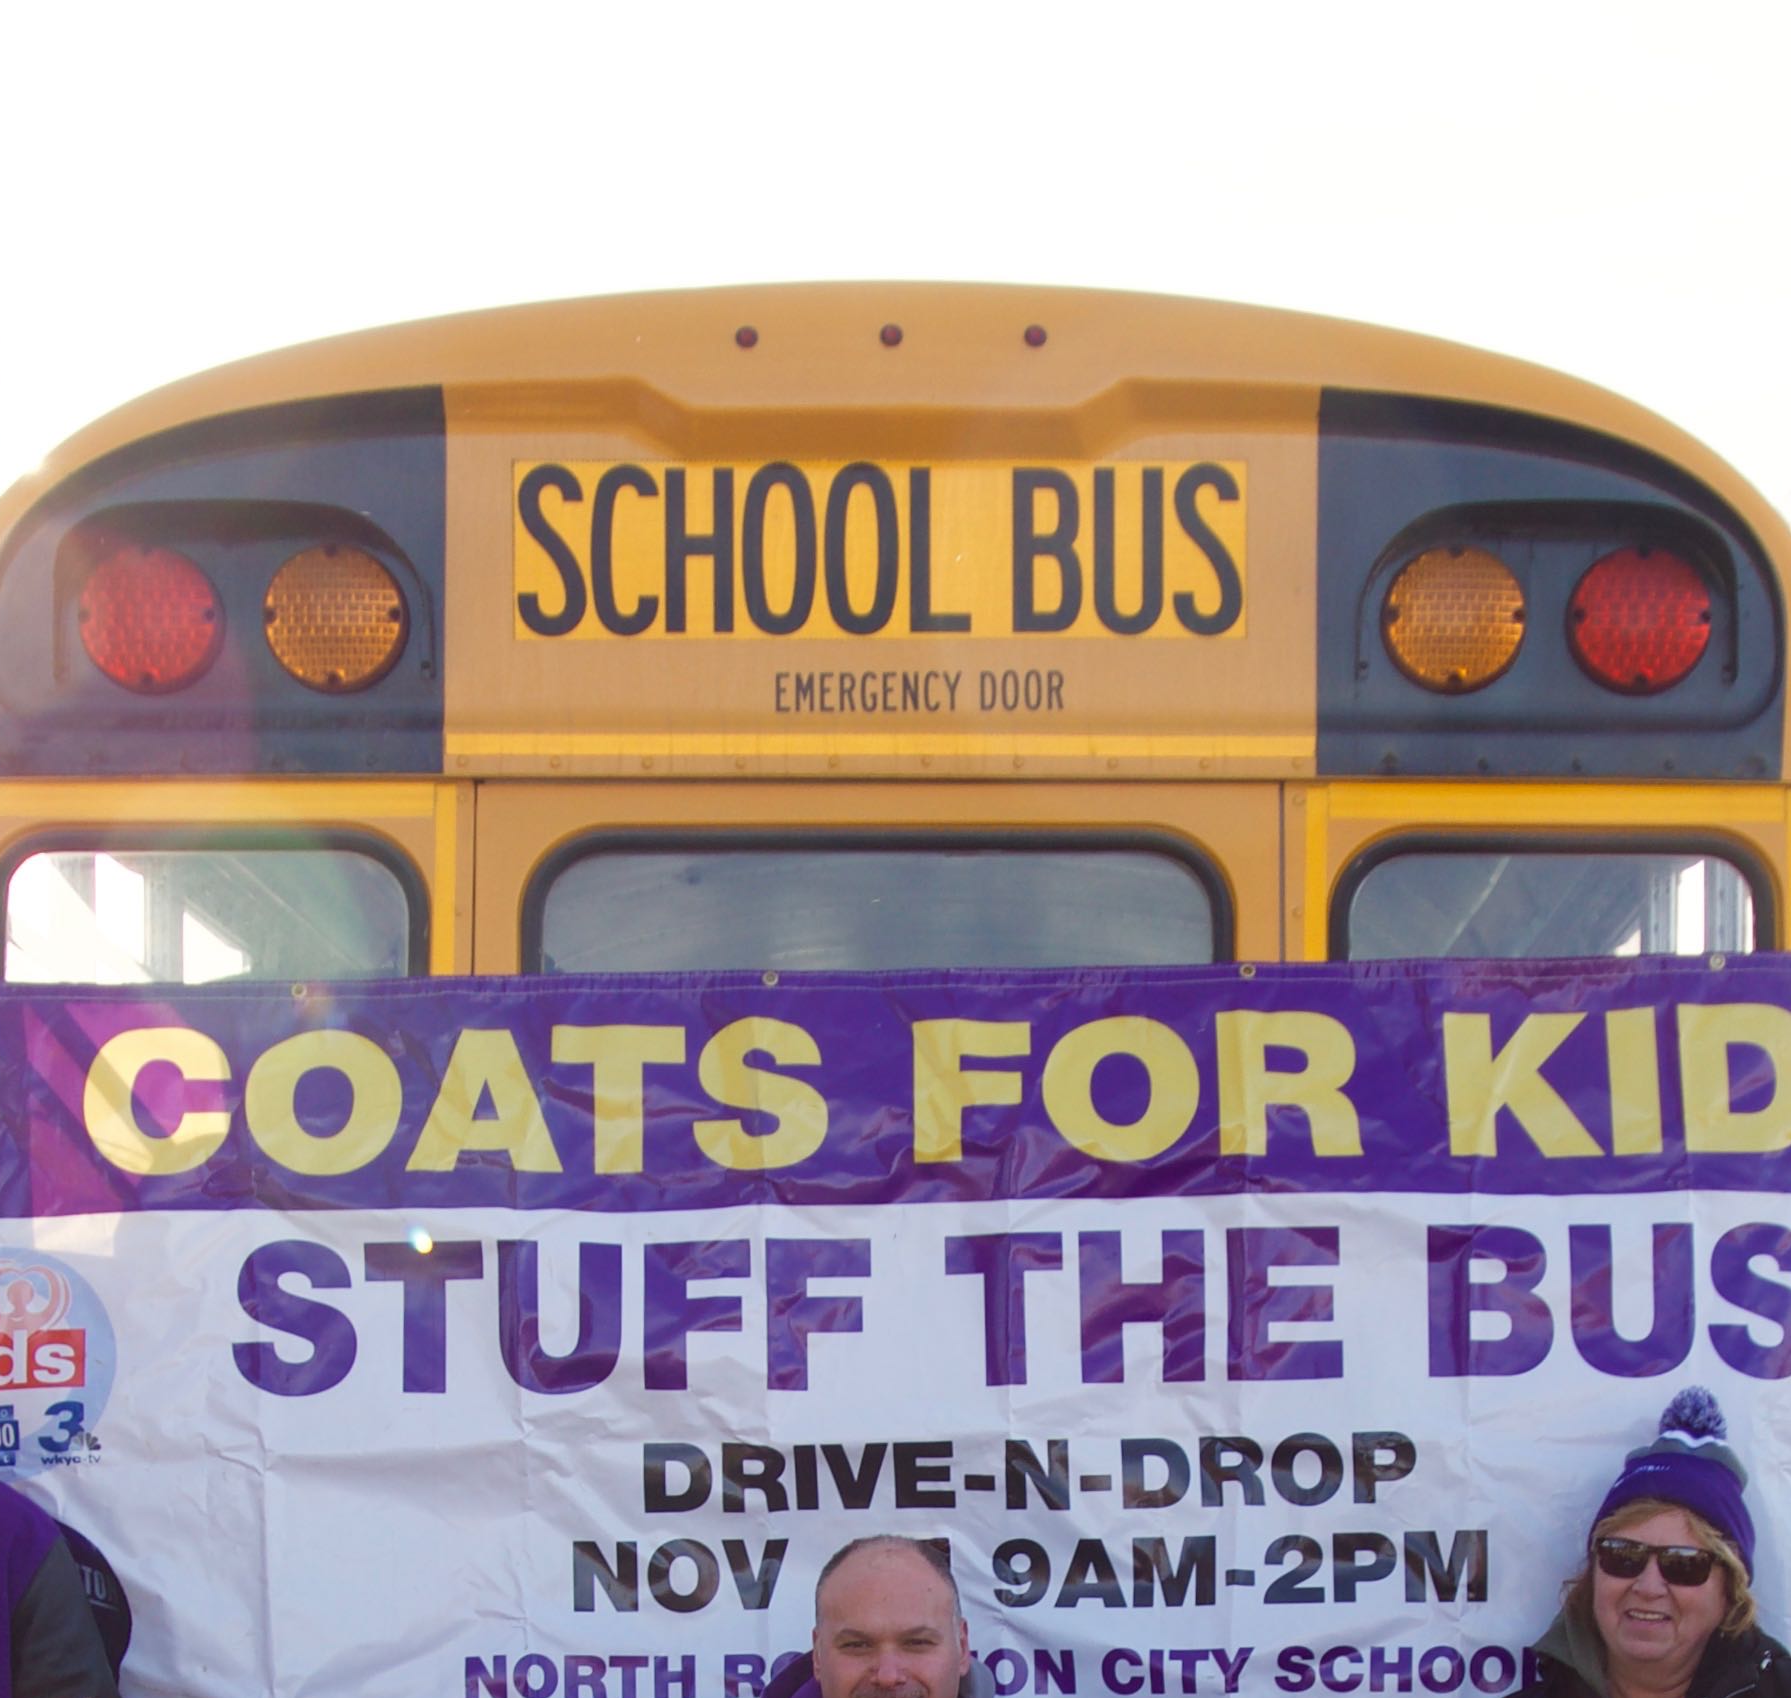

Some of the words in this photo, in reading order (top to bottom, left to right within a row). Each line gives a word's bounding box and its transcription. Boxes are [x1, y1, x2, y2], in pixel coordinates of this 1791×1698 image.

[517, 462, 971, 636] SCHOOL
[1012, 462, 1243, 635] BUS
[775, 671, 962, 713] EMERGENCY
[980, 670, 1065, 711] DOOR
[84, 1017, 829, 1177] COATS
[912, 1011, 1364, 1163] FOR
[232, 1237, 871, 1396] STUFF
[944, 1227, 1345, 1386] THE
[38, 1401, 84, 1453] 3
[643, 1431, 1416, 1514] DRIVE-N-DROP
[572, 1538, 788, 1613] NOV
[992, 1530, 1489, 1608] 9AM-2PM
[1101, 1647, 1254, 1695] CITY
